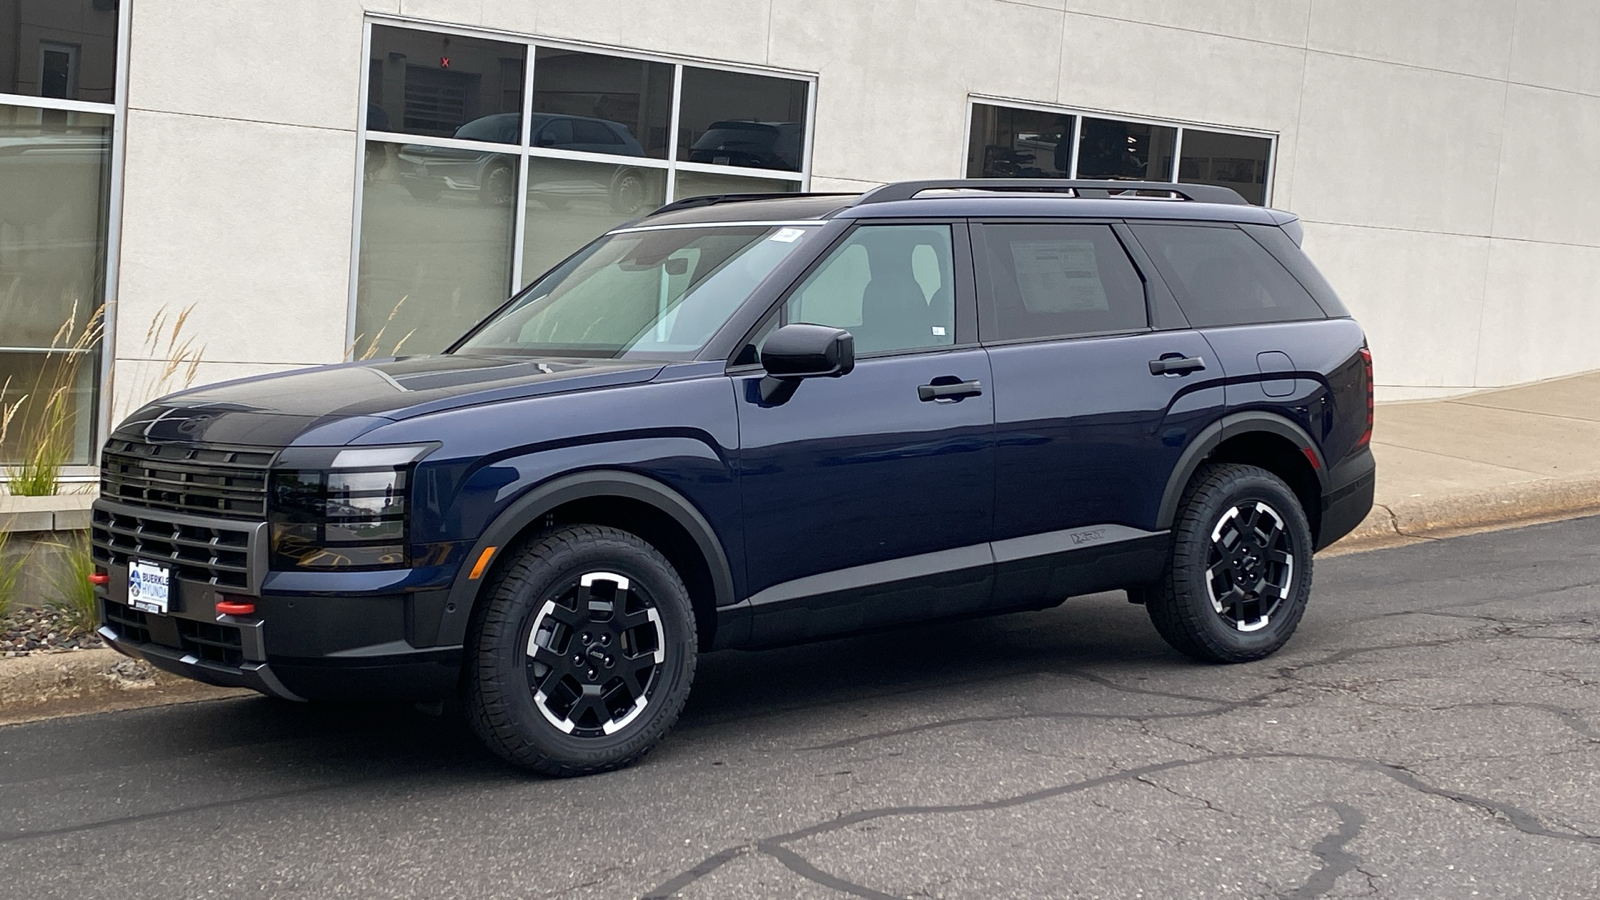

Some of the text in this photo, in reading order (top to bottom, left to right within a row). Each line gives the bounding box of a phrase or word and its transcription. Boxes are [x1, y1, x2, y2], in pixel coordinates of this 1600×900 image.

[1070, 529, 1106, 545] XRT
[142, 572, 169, 587] BUERKLE
[585, 697, 674, 760] CONTINENTAL
